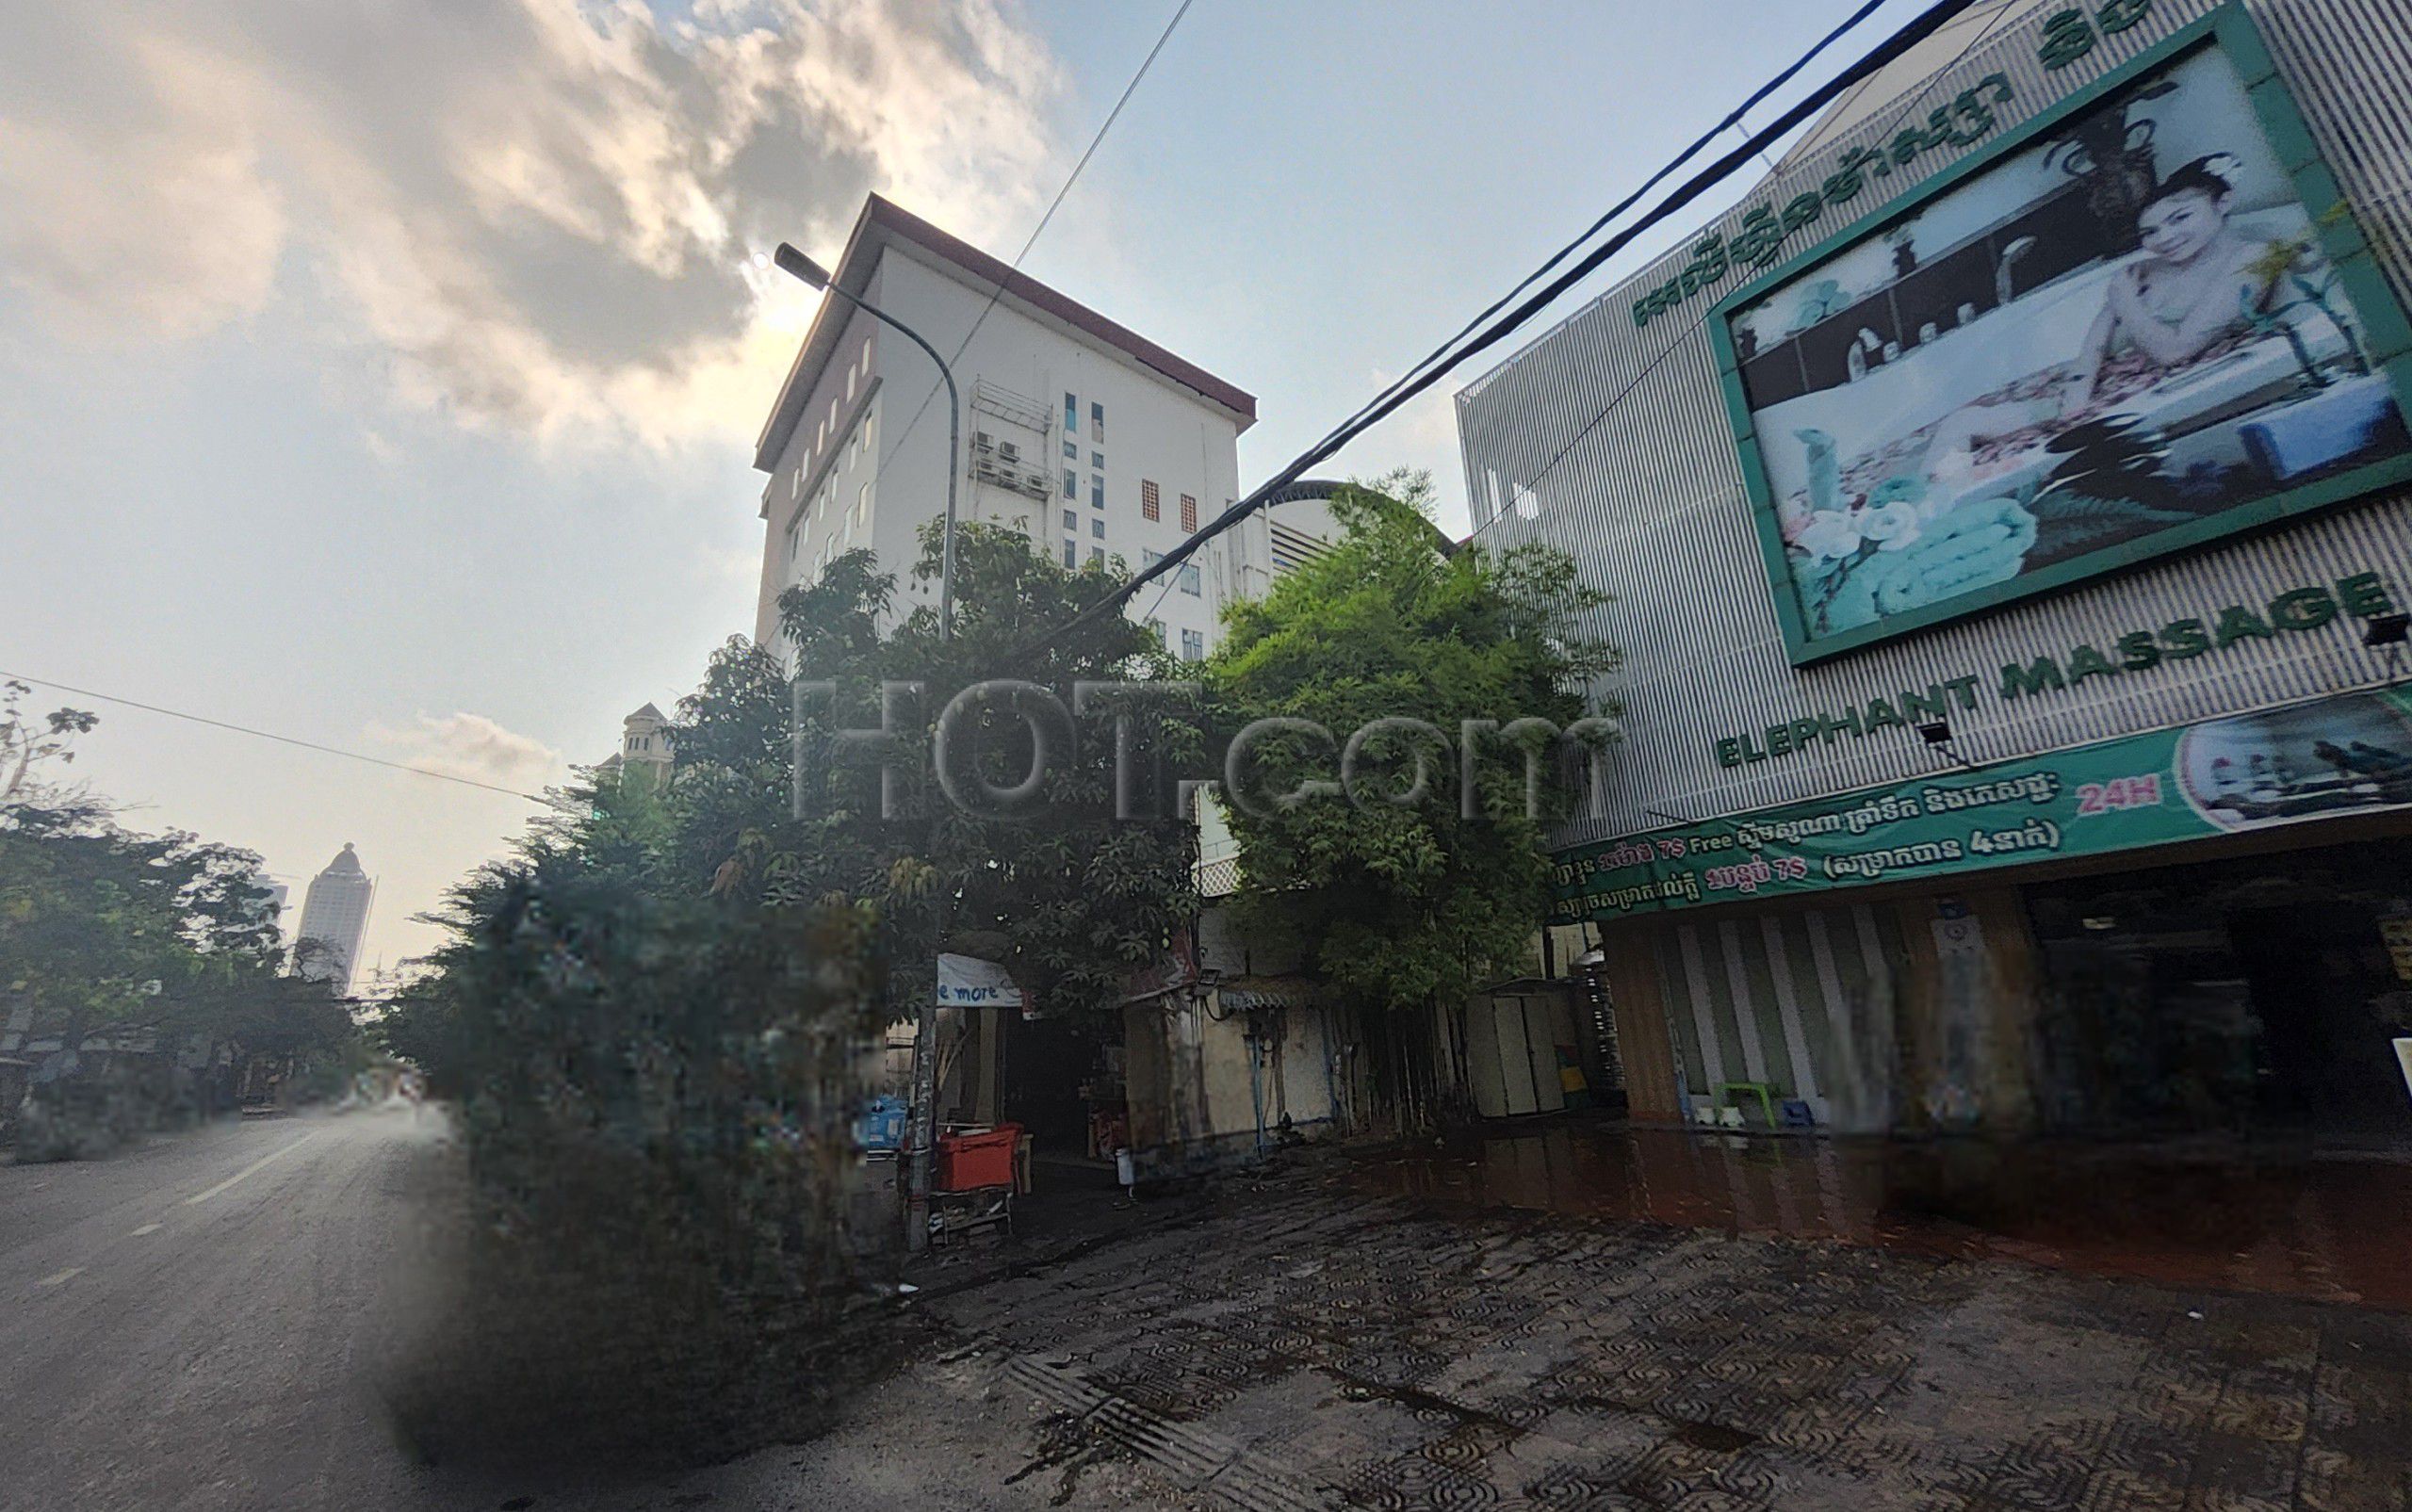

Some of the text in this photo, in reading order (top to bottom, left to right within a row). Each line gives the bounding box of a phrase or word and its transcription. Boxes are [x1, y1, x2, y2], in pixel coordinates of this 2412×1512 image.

[1717, 571, 2393, 769] ELEPHANT MASSAGE
[1656, 838, 1687, 859] 7$
[1689, 835, 1734, 854] Free
[2076, 773, 2162, 817] 24H
[1772, 855, 1808, 881] 7$
[953, 984, 999, 1002] more
